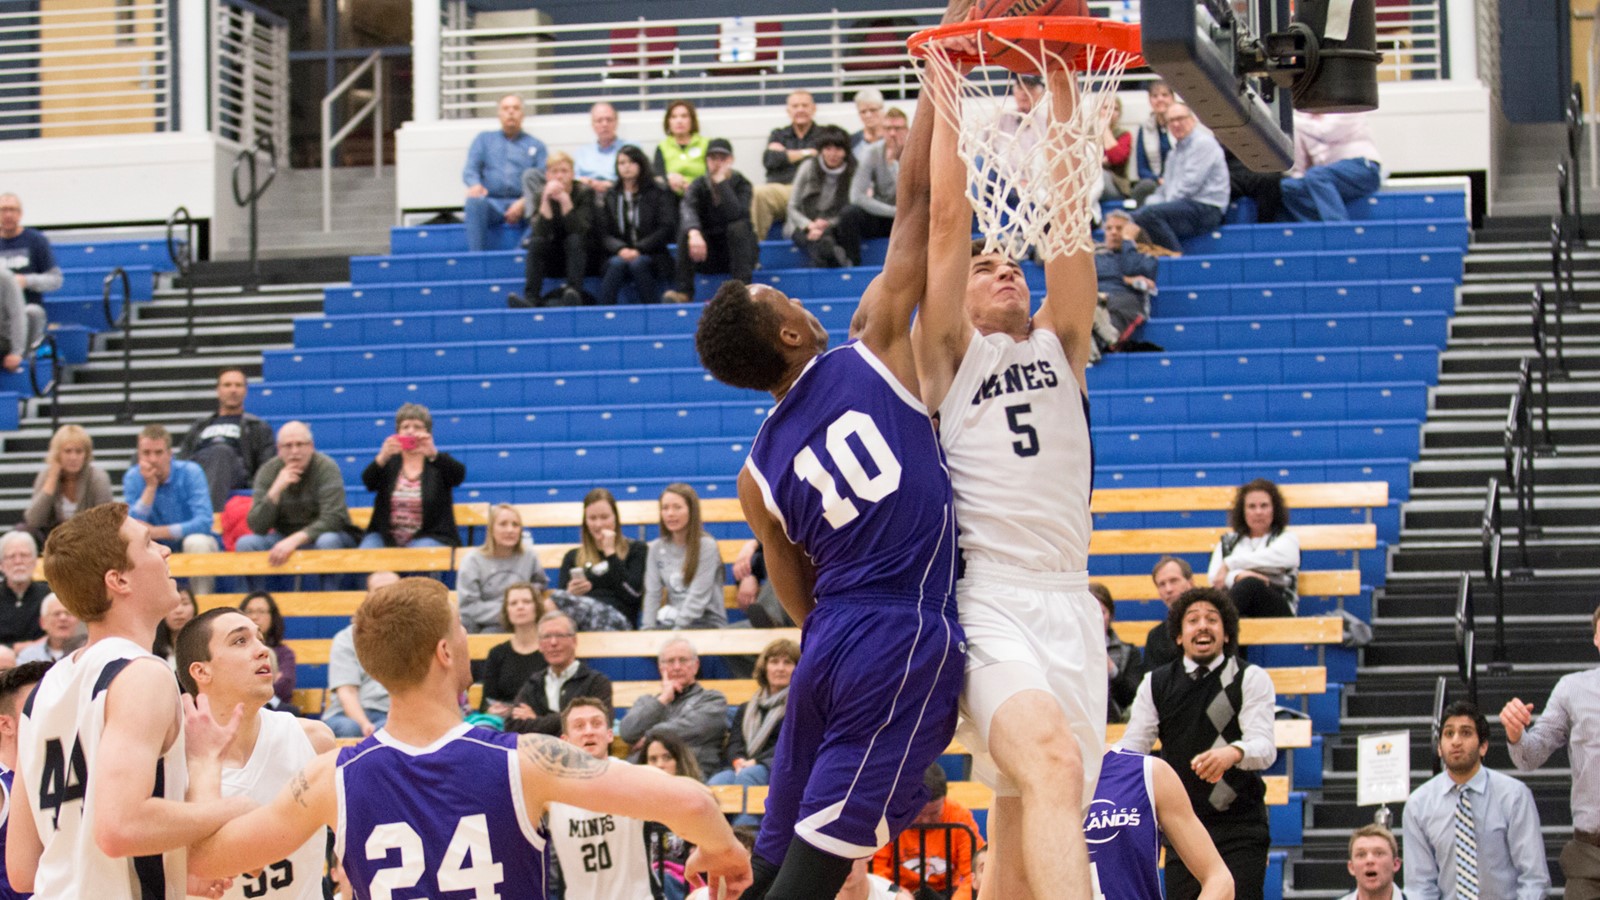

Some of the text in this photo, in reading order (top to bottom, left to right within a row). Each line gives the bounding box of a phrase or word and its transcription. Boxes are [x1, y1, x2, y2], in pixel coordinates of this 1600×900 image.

[971, 359, 1058, 405] MINES
[1005, 403, 1040, 458] 5
[794, 409, 902, 530] 10
[39, 729, 88, 832] 44
[1089, 807, 1138, 818] EXICO
[365, 813, 504, 900] 24
[581, 841, 612, 873] 20
